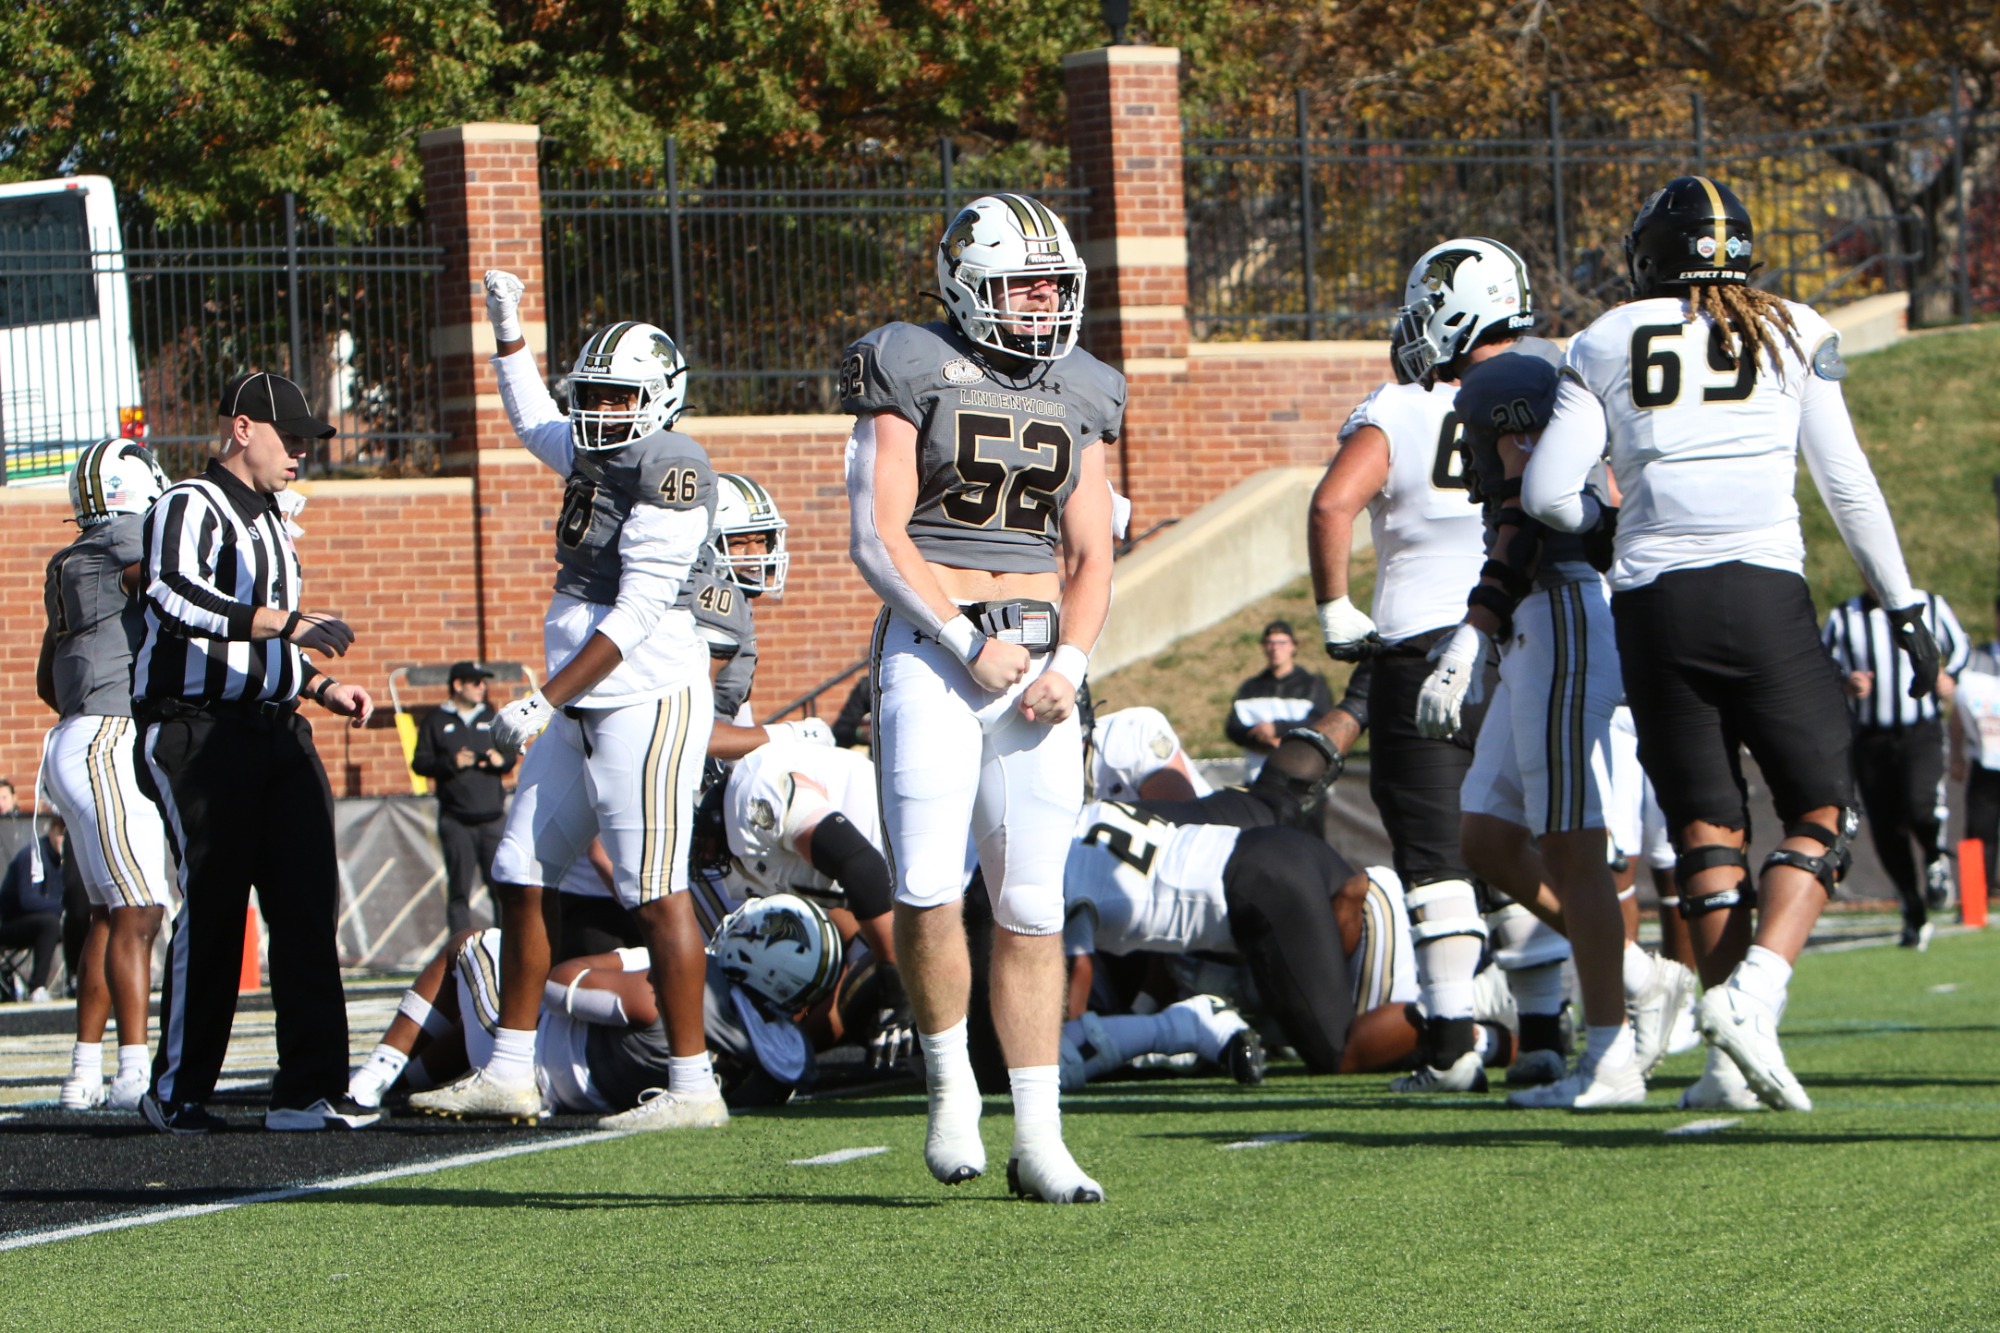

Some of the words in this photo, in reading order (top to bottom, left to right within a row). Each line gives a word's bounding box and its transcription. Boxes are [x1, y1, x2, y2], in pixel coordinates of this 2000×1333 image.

[1679, 270, 1719, 279] EXPECT
[1721, 270, 1733, 279] TO
[582, 365, 608, 373] Riddell
[1630, 323, 1757, 411] 69
[960, 389, 1066, 418] LINDENWOOD
[658, 467, 698, 503] 46
[940, 409, 1073, 535] 52
[248, 526, 260, 540] S
[697, 584, 735, 616] 40
